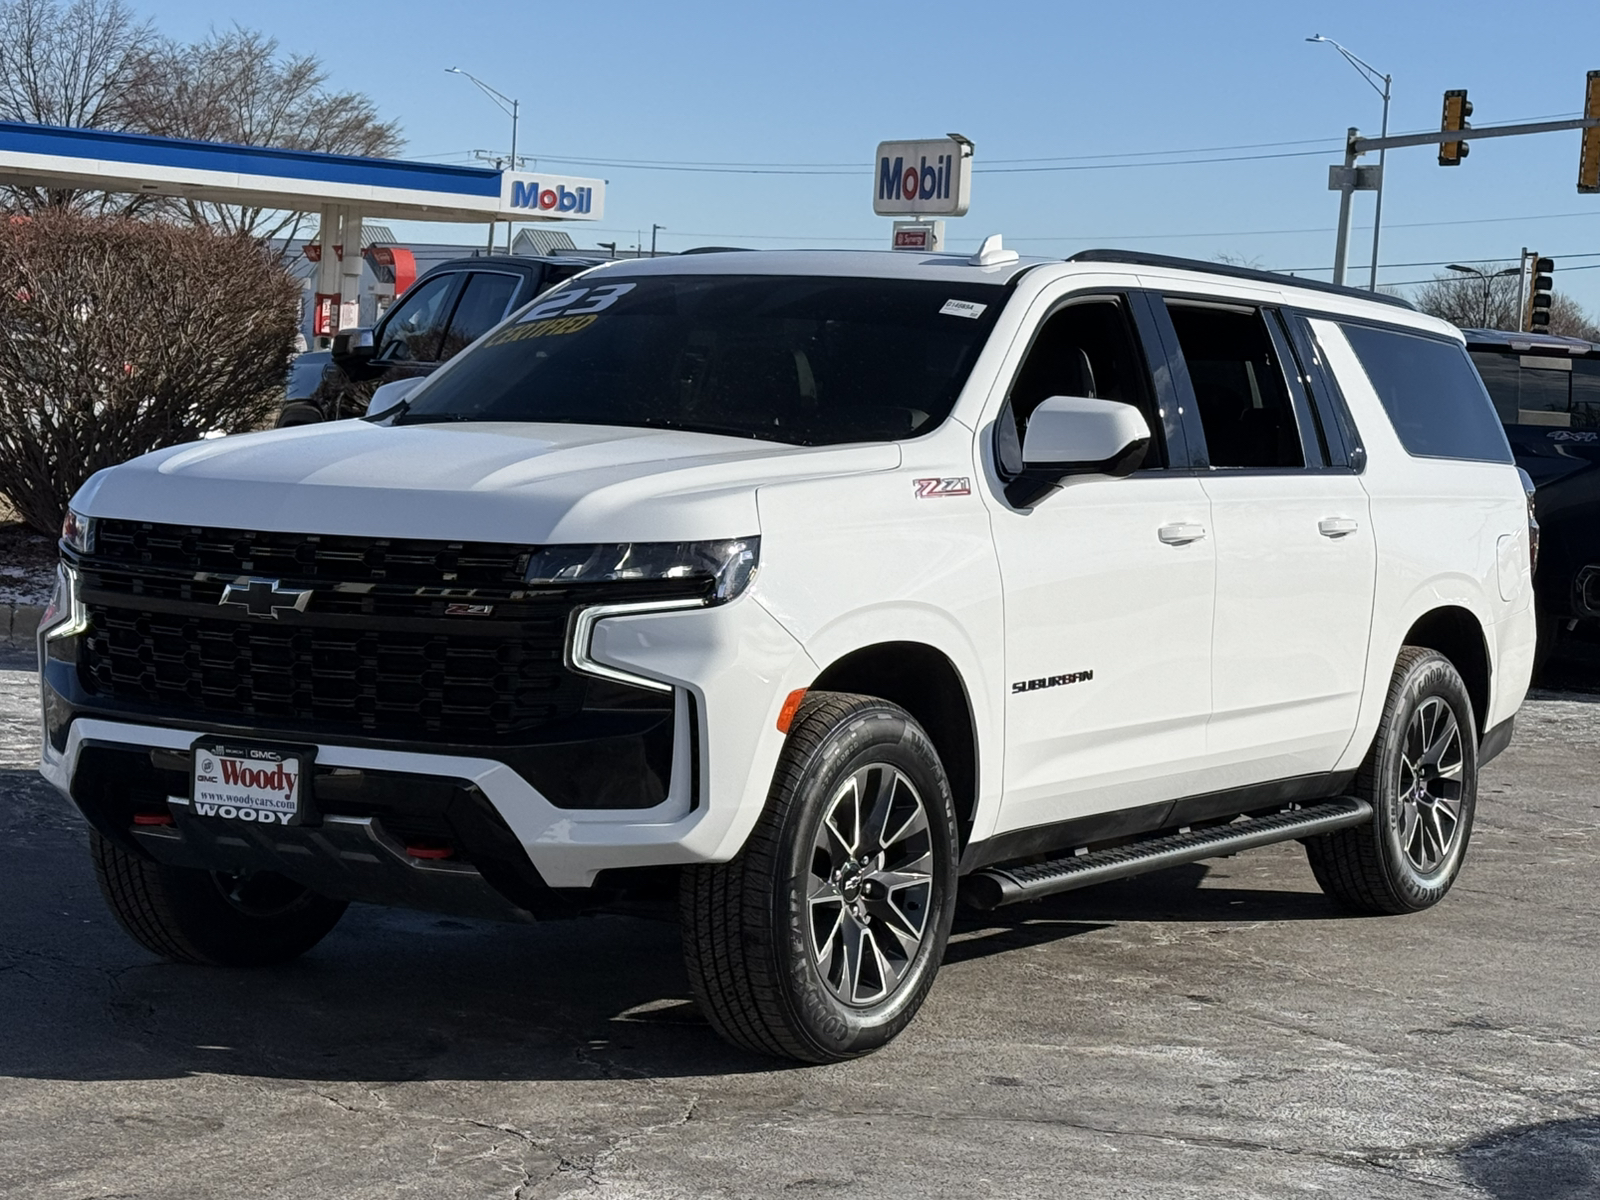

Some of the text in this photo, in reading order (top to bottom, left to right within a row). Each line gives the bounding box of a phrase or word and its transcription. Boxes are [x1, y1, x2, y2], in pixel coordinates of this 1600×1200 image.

[879, 155, 951, 200] Mobil
[511, 181, 592, 214] Mobil
[516, 283, 637, 324] 23
[484, 314, 599, 348] CERTIFIED
[913, 477, 971, 499] Z71
[445, 603, 494, 616] Z71
[1012, 669, 1093, 694] SUBURBAN
[250, 750, 277, 760] GMC
[197, 775, 217, 783] GMC
[220, 758, 298, 800] Woody
[200, 791, 295, 810] www.woodycars.com
[195, 802, 294, 825] WOODY
